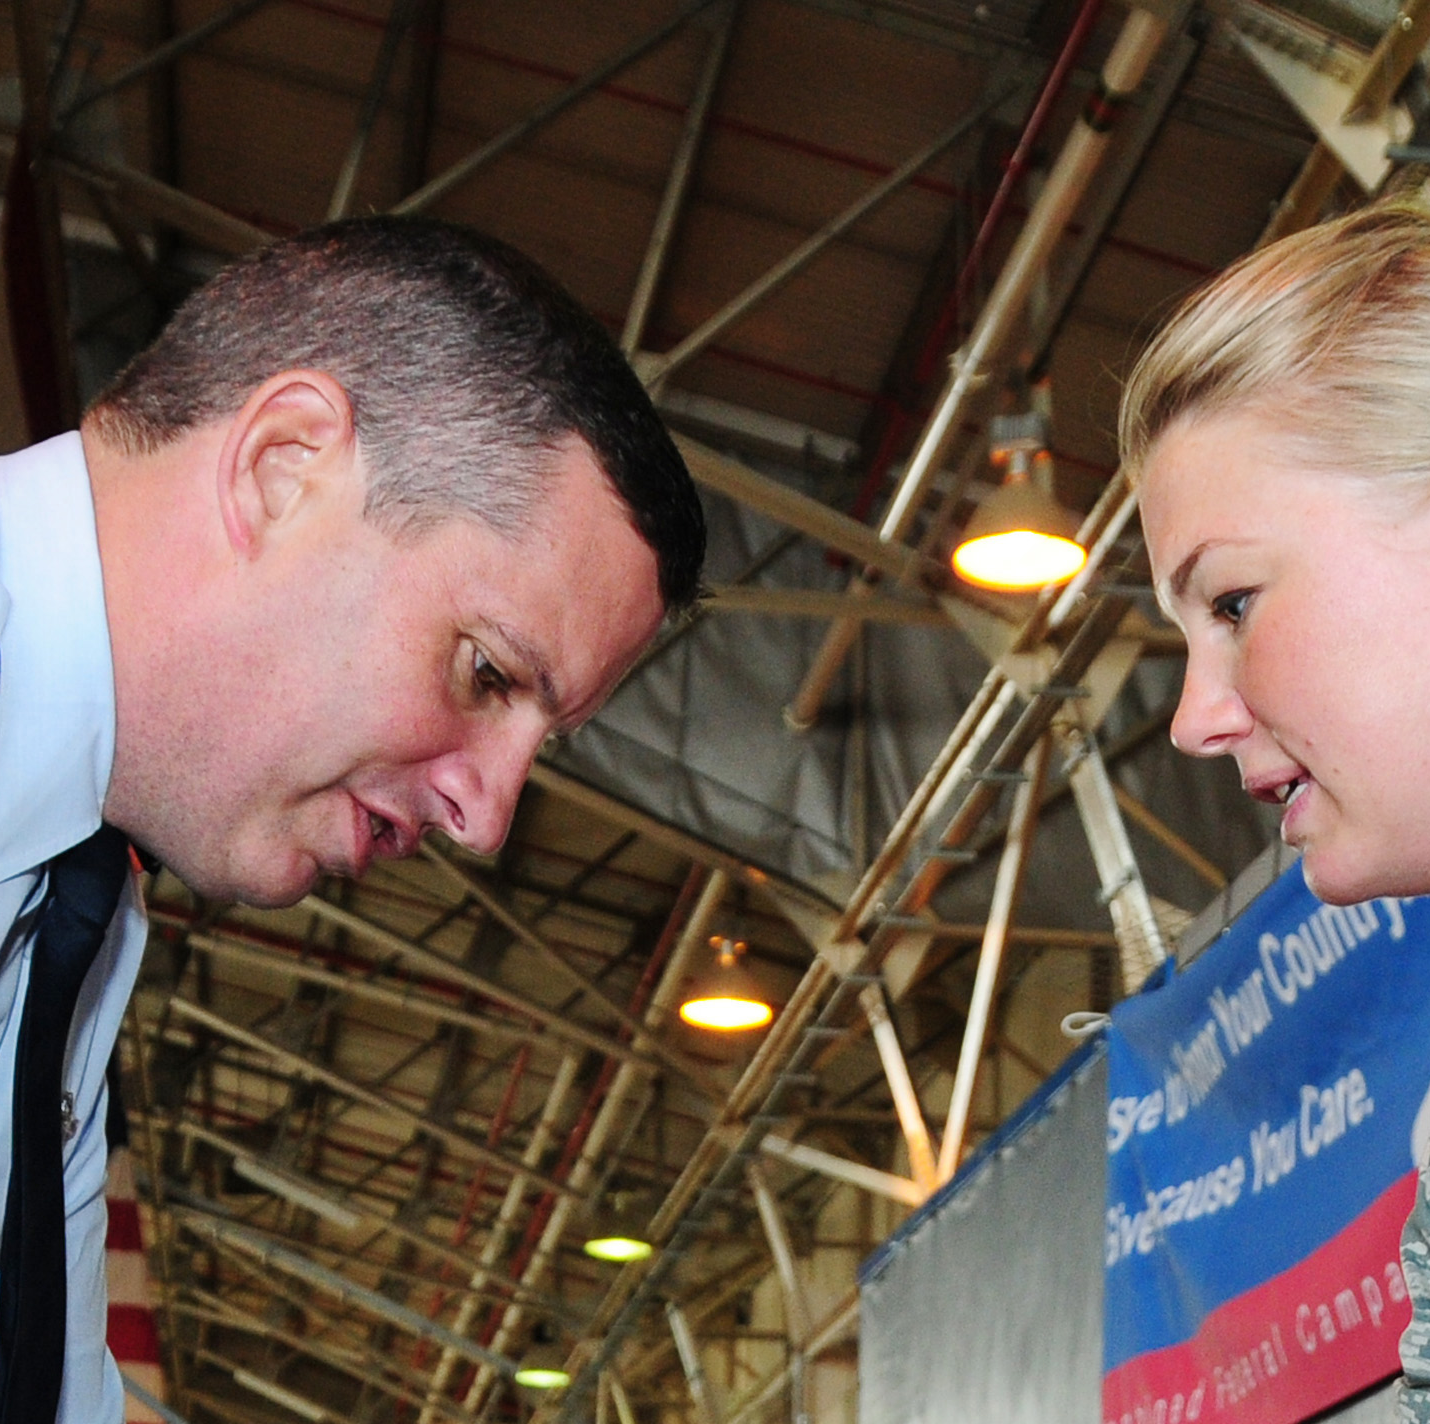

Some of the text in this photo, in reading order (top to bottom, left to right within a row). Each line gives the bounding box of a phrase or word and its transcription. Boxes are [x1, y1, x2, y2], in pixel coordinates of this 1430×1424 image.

[1208, 968, 1274, 1056] Your
[1249, 1119, 1297, 1193] You
[1298, 1068, 1376, 1158] Care.
